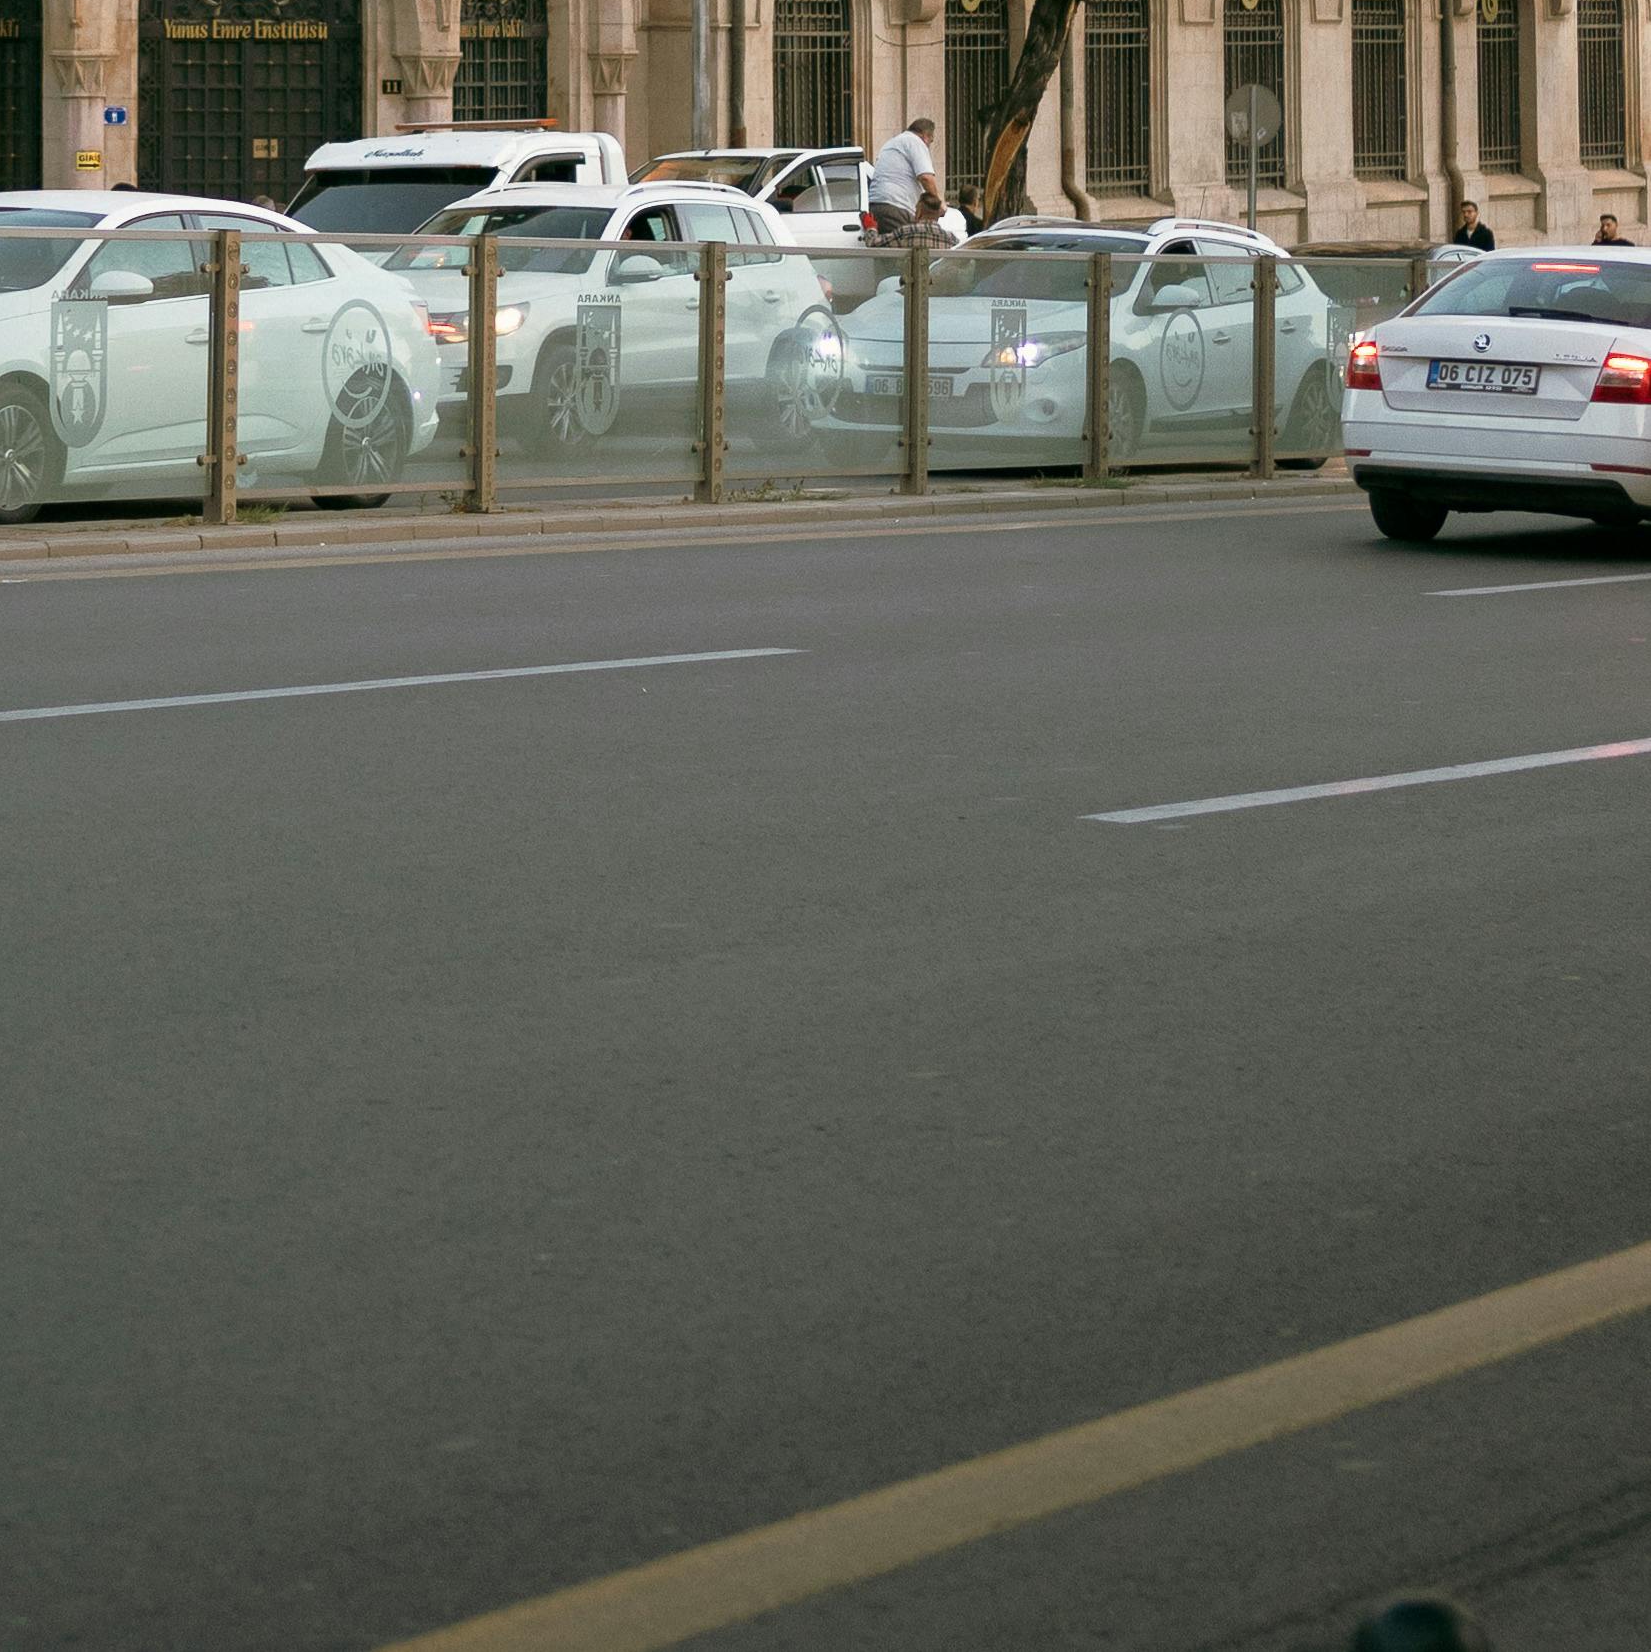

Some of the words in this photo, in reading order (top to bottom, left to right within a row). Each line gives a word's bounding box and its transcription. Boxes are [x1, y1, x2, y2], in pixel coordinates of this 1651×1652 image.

[164, 19, 208, 39] Yunus
[212, 19, 251, 39] Emre
[255, 19, 328, 39] Enstitüsü
[386, 81, 398, 93] 11
[1439, 364, 1459, 381] 06
[1465, 366, 1496, 383] CIZ
[1501, 368, 1533, 385] 075
[875, 378, 889, 393] 06
